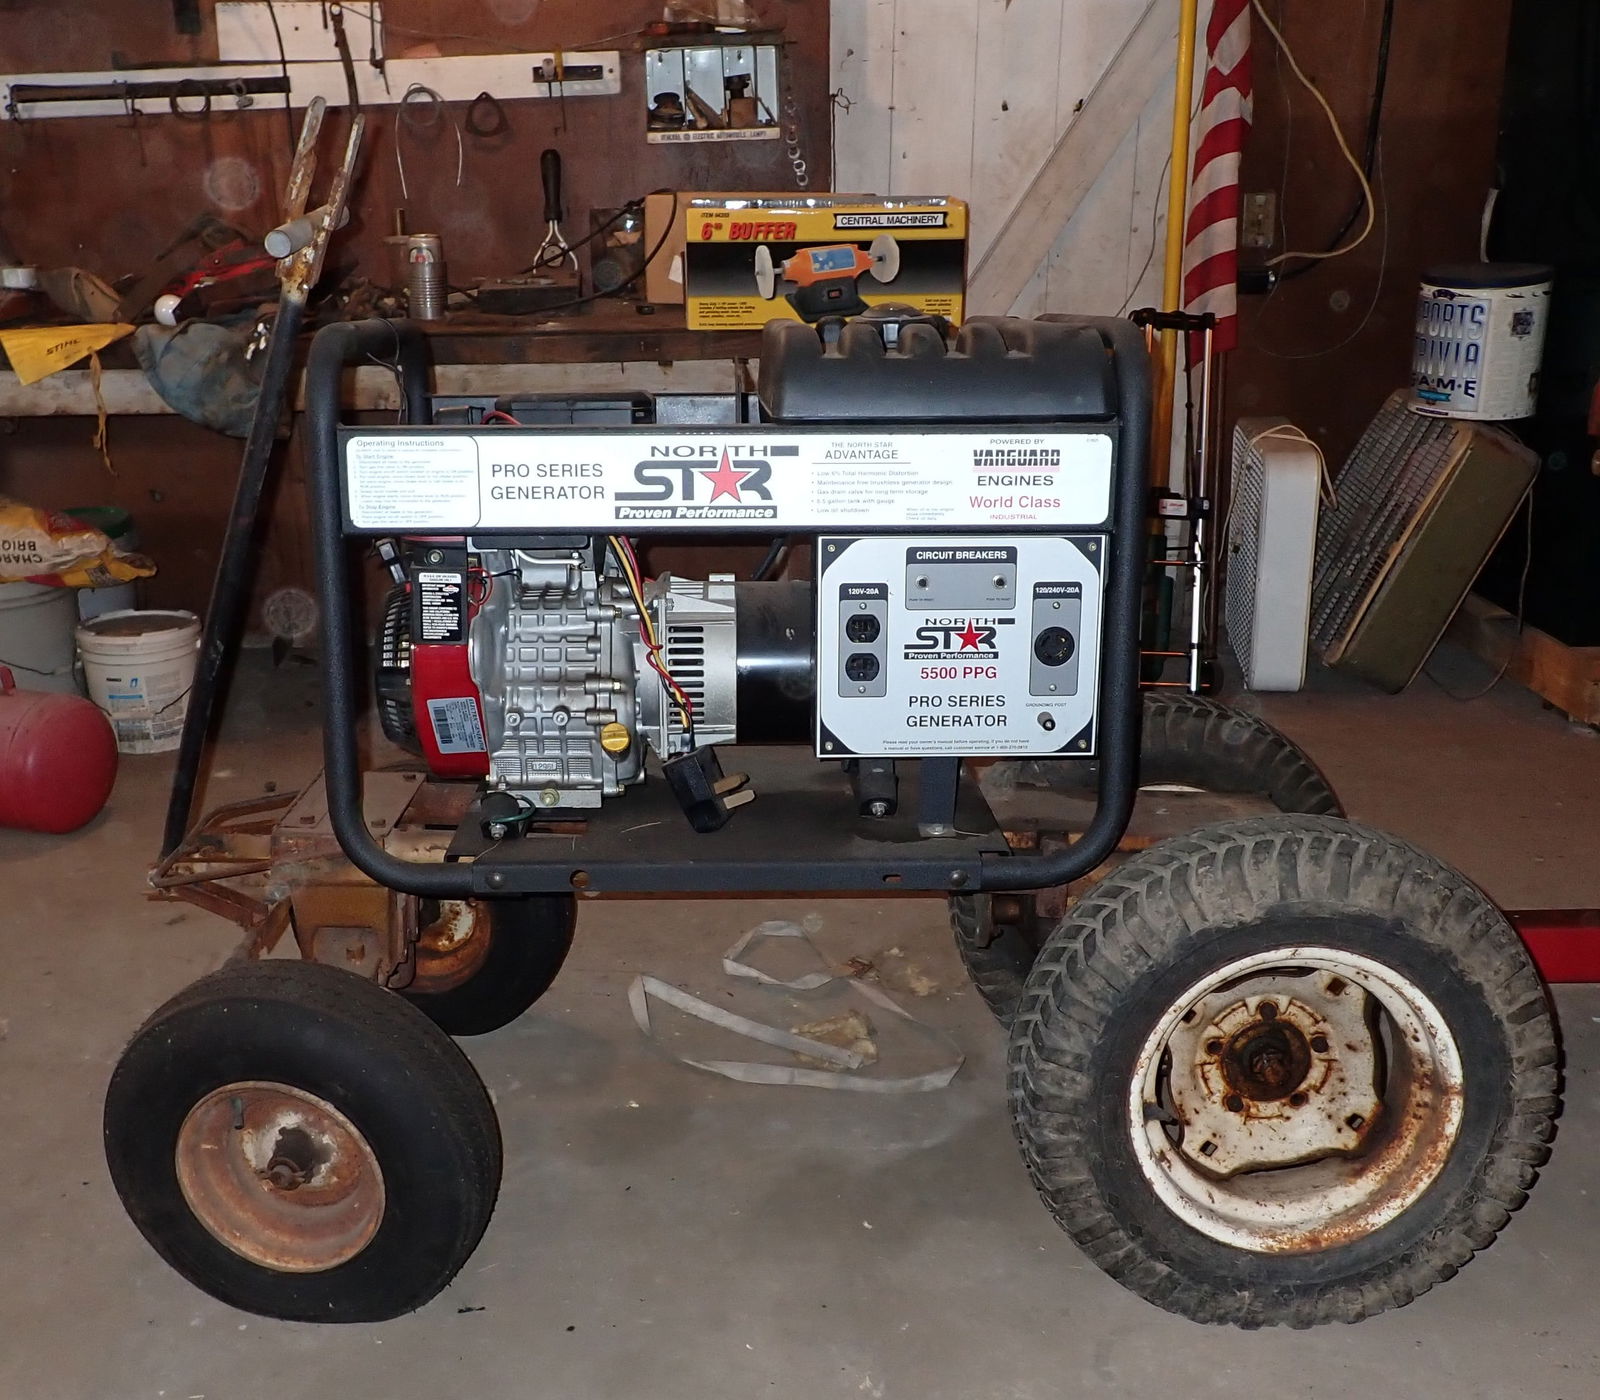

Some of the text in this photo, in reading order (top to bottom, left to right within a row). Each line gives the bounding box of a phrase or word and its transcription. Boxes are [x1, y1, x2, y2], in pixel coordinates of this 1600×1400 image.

[840, 214, 940, 226] CENTRAL MACHINERY
[701, 222, 797, 240] 6" BUFFER
[1416, 301, 1484, 340] PORTS
[356, 440, 396, 448] Operating
[650, 445, 768, 458] NORTH
[824, 450, 899, 460] ADVANTAGE
[972, 449, 1060, 467] VANGUARD
[492, 464, 530, 478] PRO
[536, 464, 603, 478] SERIES
[977, 475, 1054, 486] ENGINES
[490, 486, 606, 500] GENERATOR
[969, 496, 1061, 508] World Class
[618, 506, 774, 519] Proven Performance
[0, 552, 42, 564] CHAR
[916, 550, 1008, 560] CIRCUIT BREAKERS
[1035, 586, 1080, 594] 120/240V-20A
[925, 618, 996, 626] NORTH
[908, 652, 994, 660] Proven Performance
[920, 666, 998, 680] 5500 PPG
[908, 695, 1006, 708] PRO SERIES
[906, 715, 1008, 728] GENERATOR
